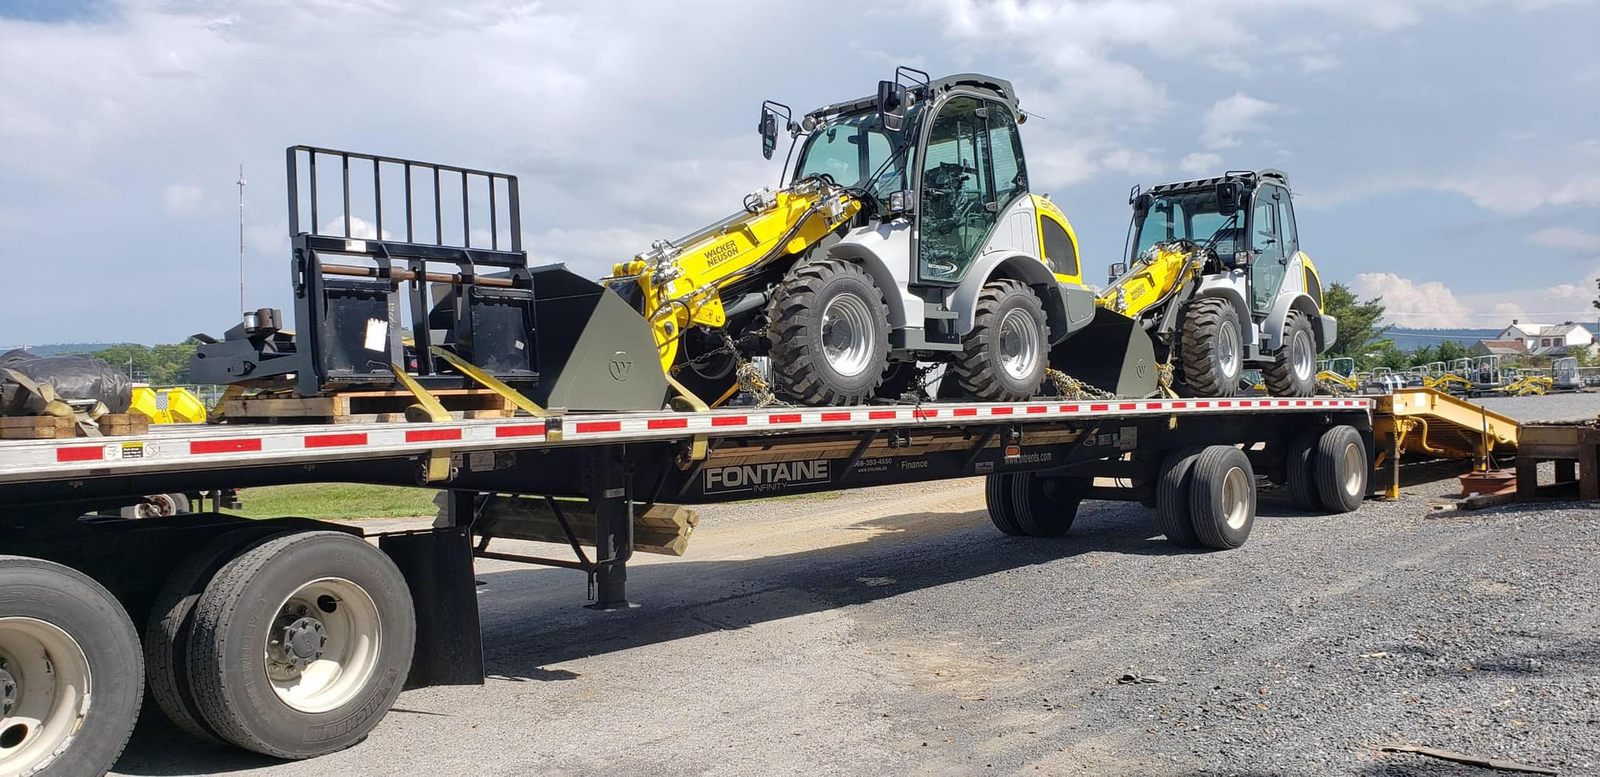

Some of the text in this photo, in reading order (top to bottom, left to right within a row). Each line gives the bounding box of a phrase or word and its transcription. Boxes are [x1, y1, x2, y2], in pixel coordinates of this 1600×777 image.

[704, 240, 736, 259] WACKER
[707, 247, 739, 267] NEUSON
[706, 460, 828, 489] FONTAINE
[901, 460, 928, 470] Finance
[753, 481, 788, 493] INFINITY
